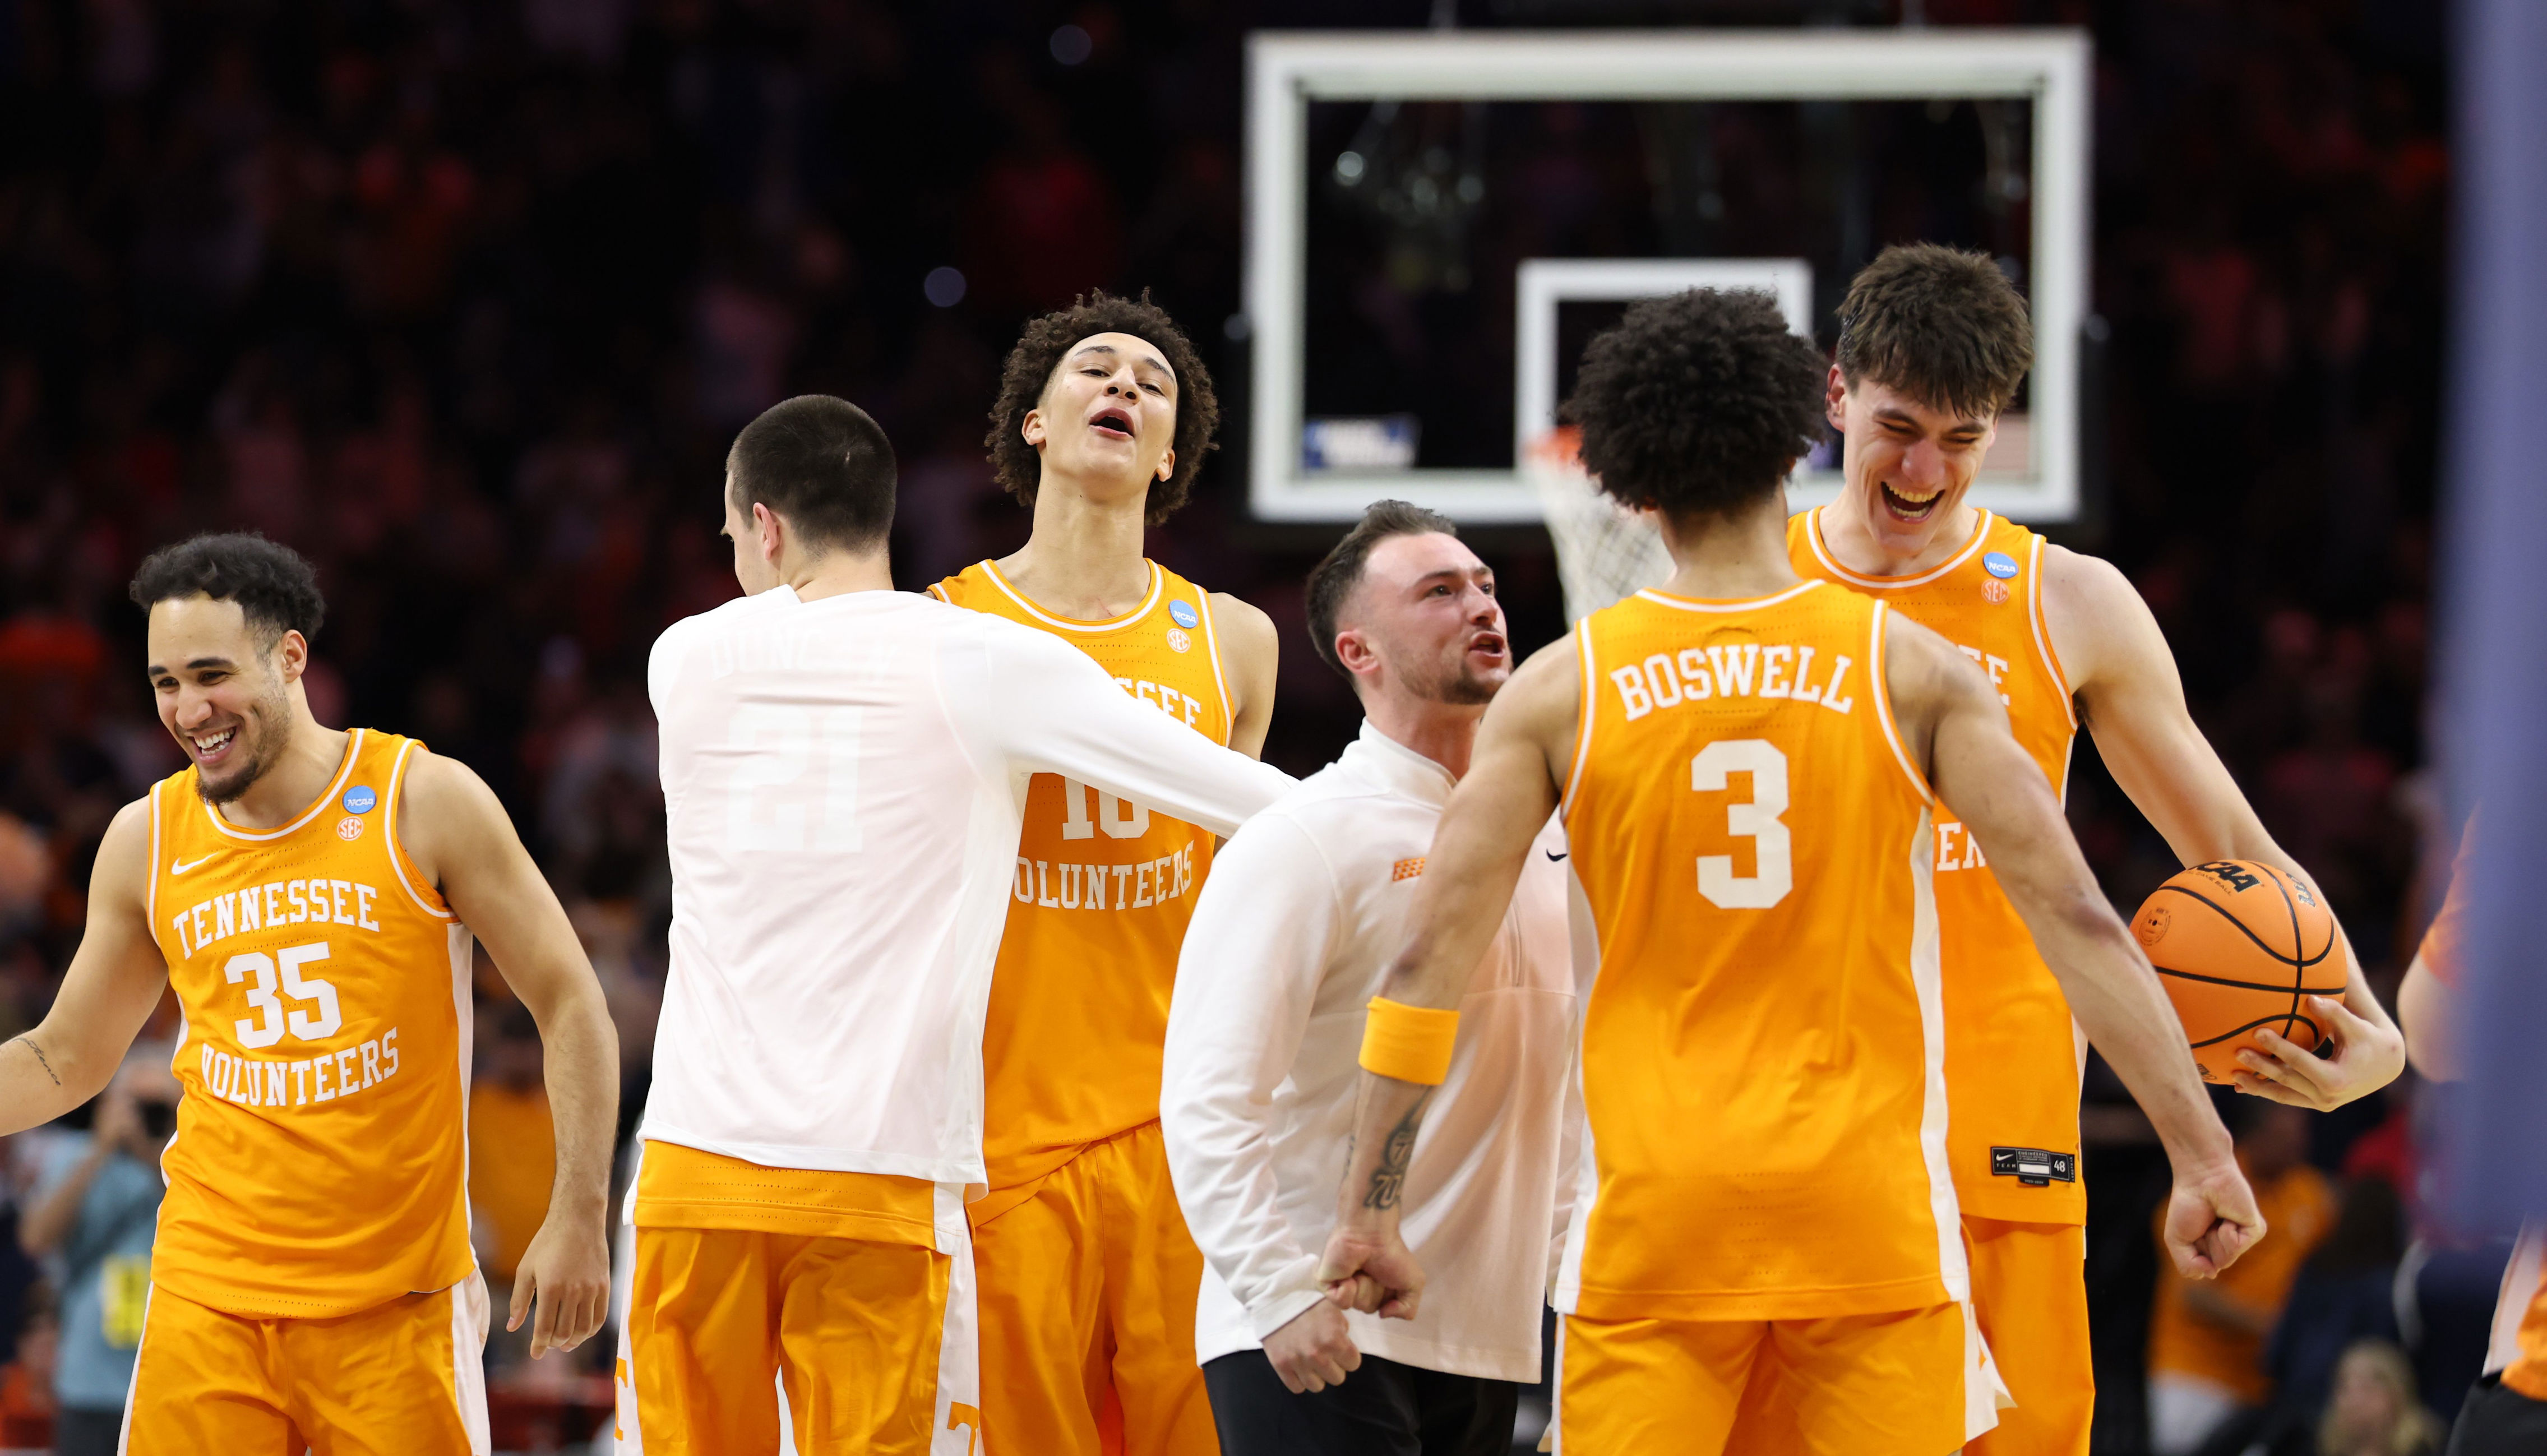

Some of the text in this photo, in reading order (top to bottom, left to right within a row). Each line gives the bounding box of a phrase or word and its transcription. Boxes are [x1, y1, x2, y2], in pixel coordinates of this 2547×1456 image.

[1988, 562, 2016, 573] NCAA
[1984, 581, 2008, 603] SEC
[1173, 610, 1196, 623] NCAA
[1169, 630, 1189, 650] SEC
[1610, 644, 1853, 722] BOSWELL
[728, 705, 863, 853] 21
[347, 798, 374, 807] NCAA
[1690, 738, 1793, 909] 3
[339, 818, 362, 839] SEC
[1014, 840, 1194, 910] OLUNTEERS
[172, 879, 380, 960] TENNESSEE
[224, 941, 342, 1049] 35
[201, 1027, 399, 1107] VOLUNTEERS
[2054, 1159, 2066, 1173] 48
